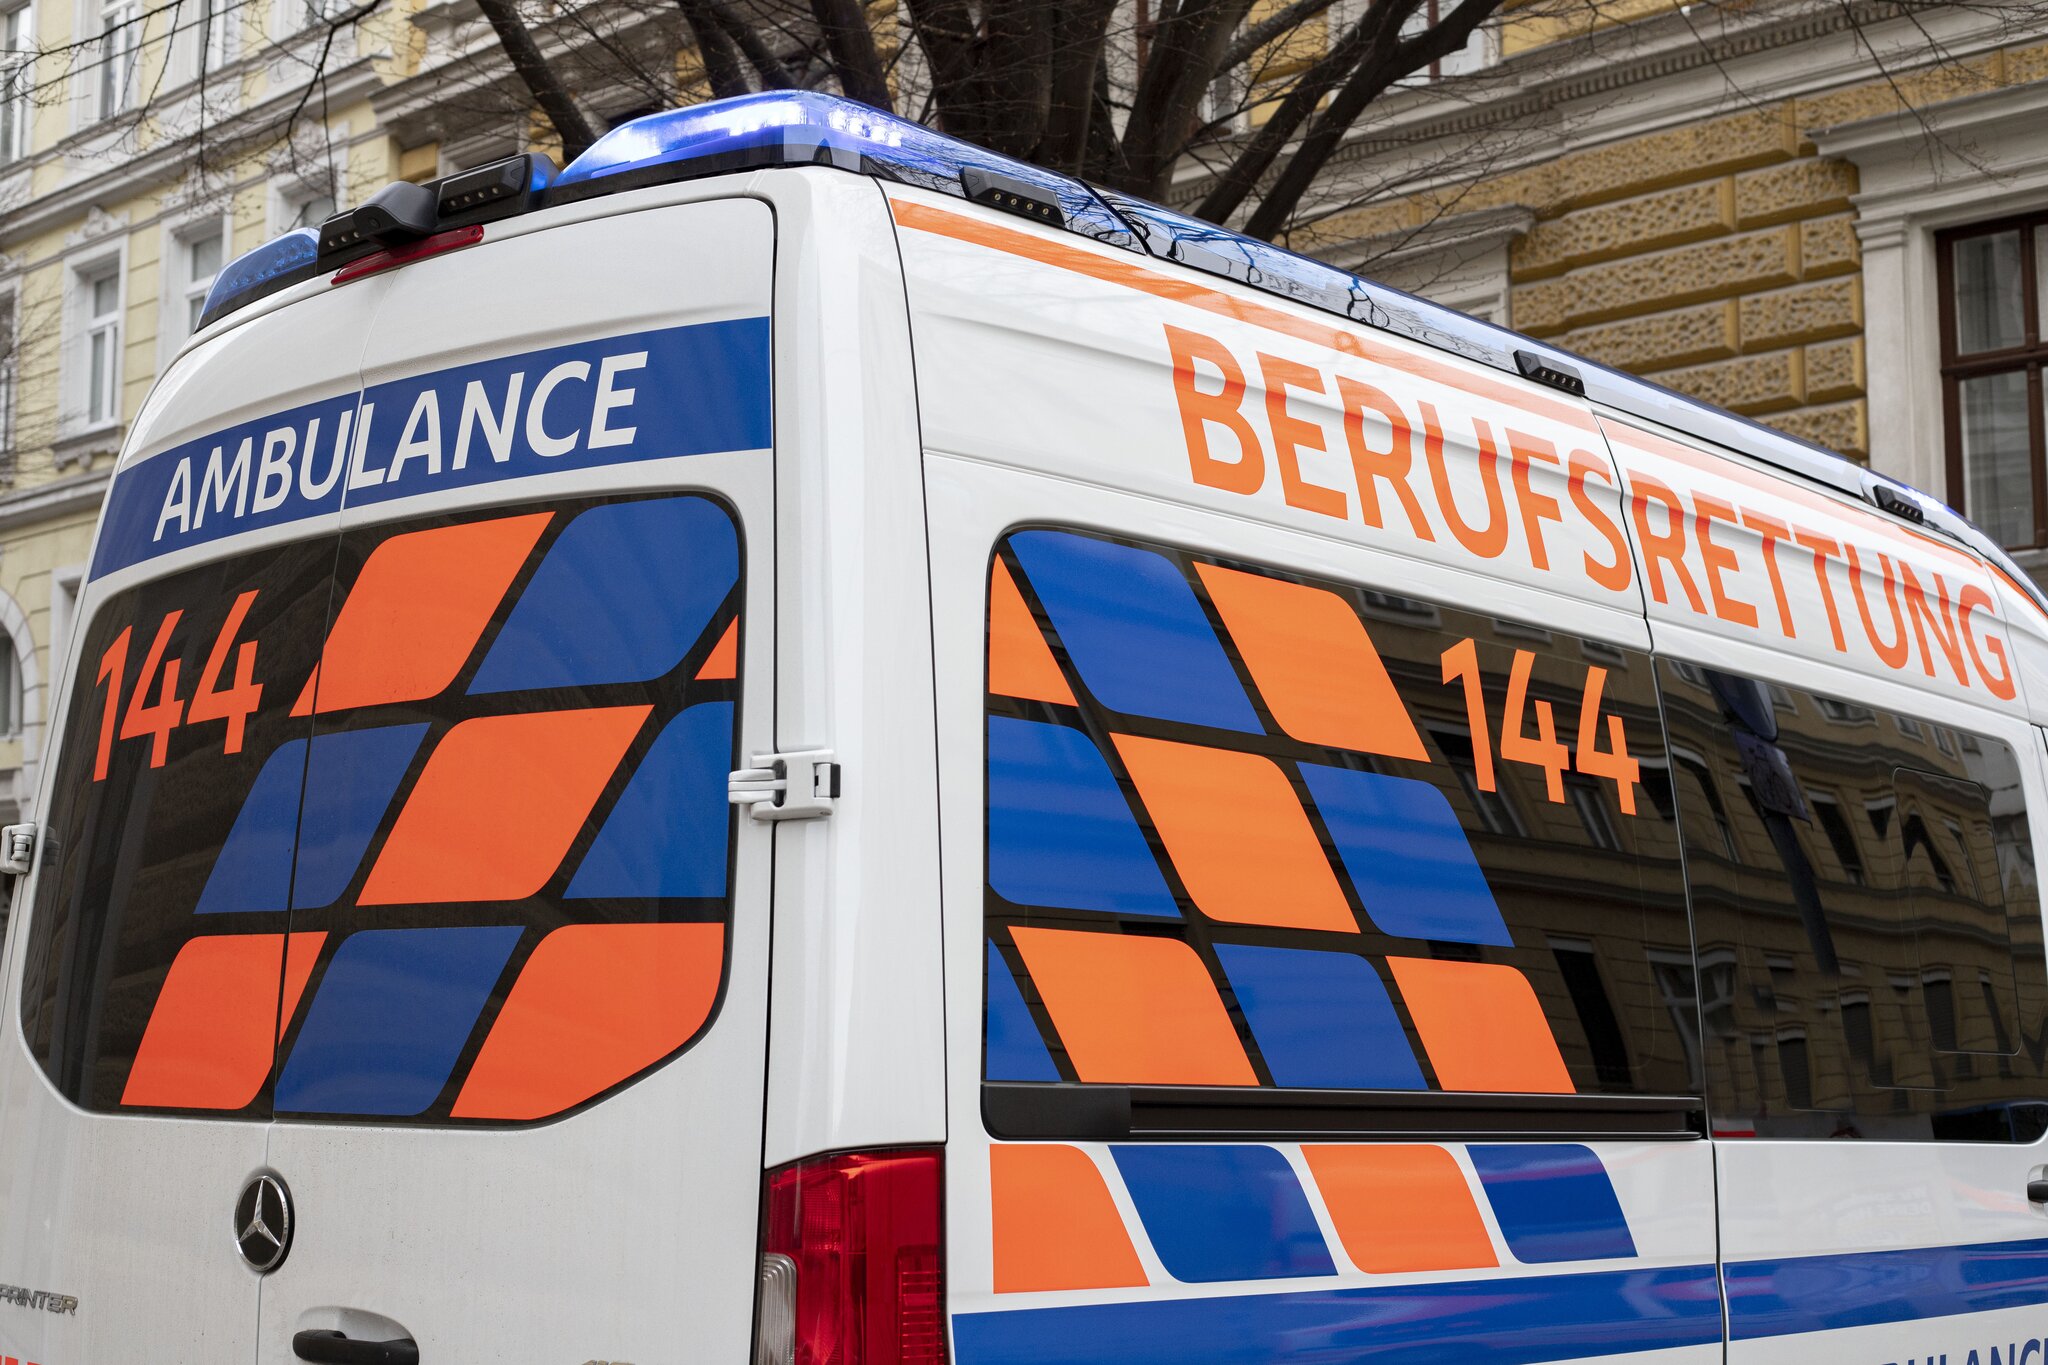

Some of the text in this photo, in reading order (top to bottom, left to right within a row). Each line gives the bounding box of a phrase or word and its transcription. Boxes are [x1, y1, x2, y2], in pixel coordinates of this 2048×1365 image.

[153, 351, 648, 542] AMBULANCE
[1163, 323, 2017, 701] BERUFSRETTUNG
[93, 589, 264, 782] 144
[1441, 637, 1640, 815] 144
